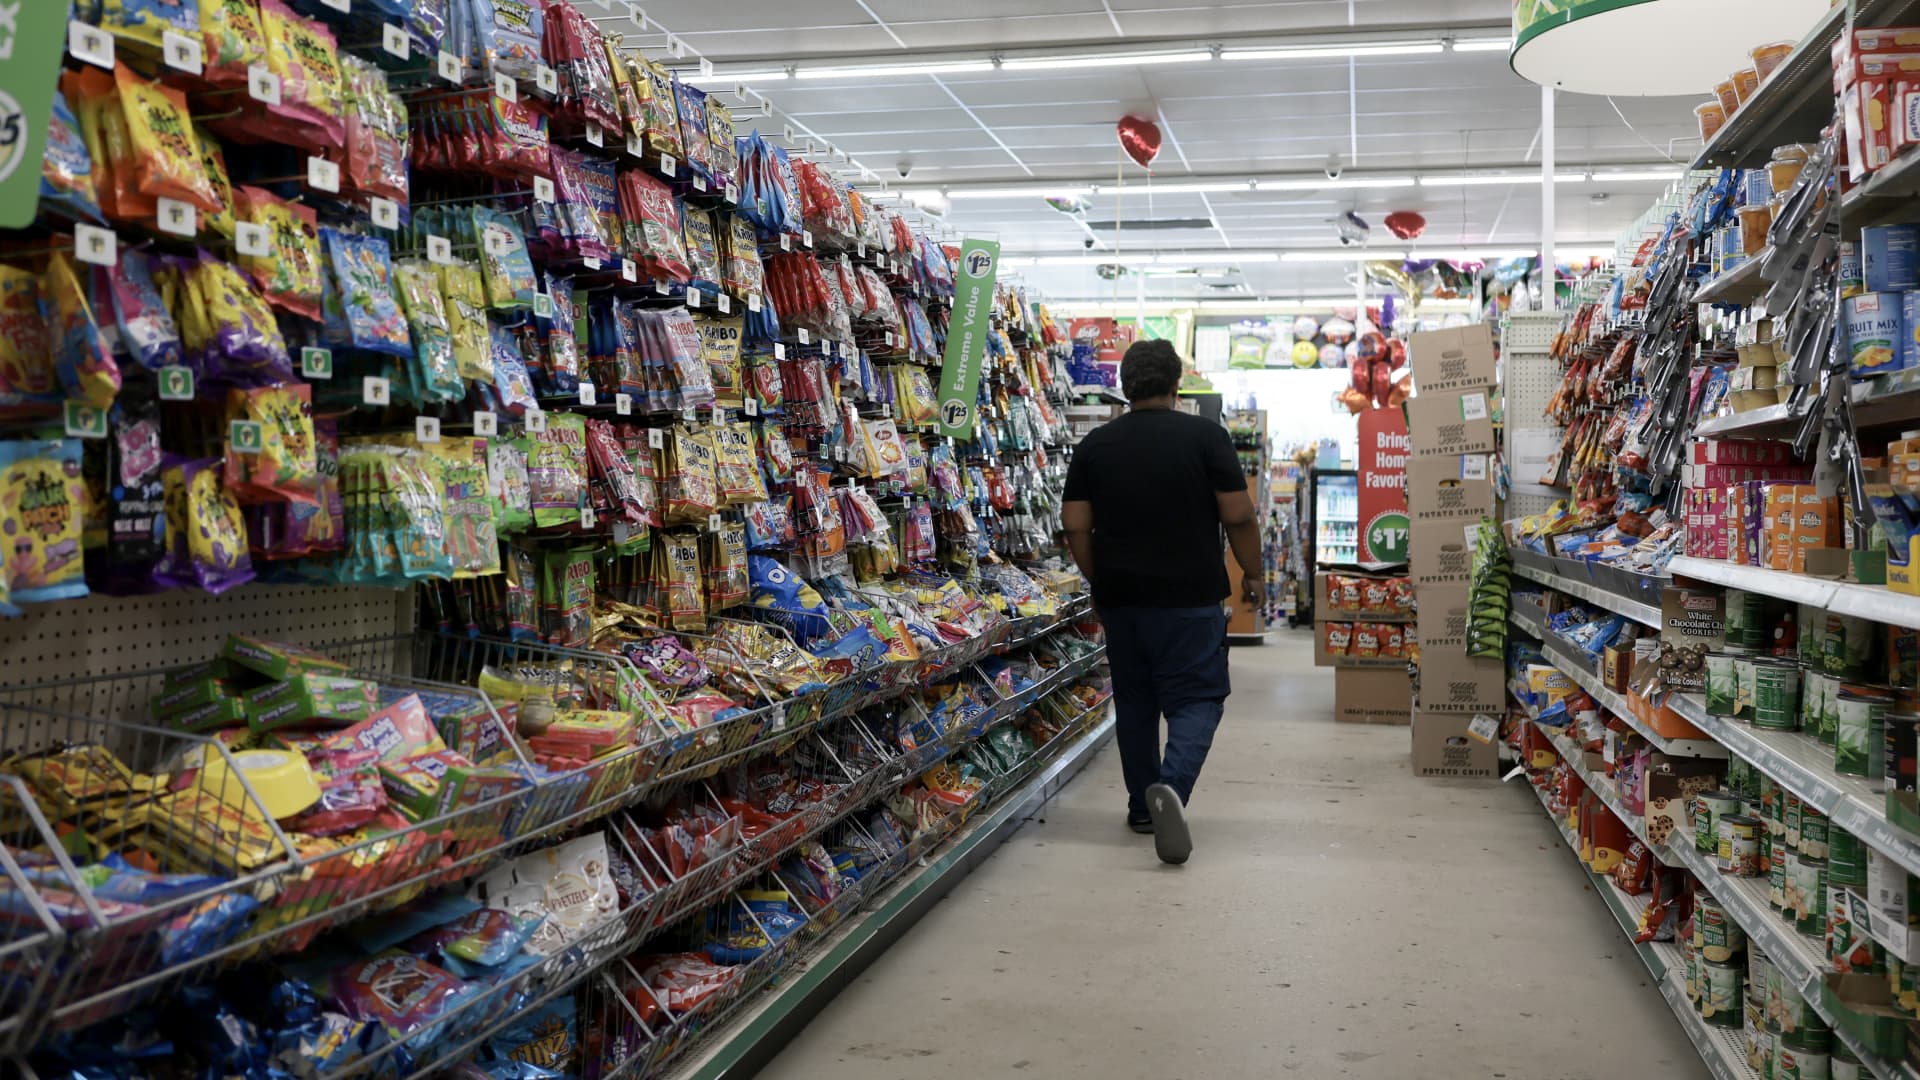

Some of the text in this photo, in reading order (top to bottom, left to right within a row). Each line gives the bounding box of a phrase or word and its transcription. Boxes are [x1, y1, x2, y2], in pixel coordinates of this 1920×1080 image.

[1876, 318, 1899, 330] MIX
[953, 285, 981, 392] Extreme Value
[1422, 376, 1489, 391] POTATO CHIPS
[1377, 431, 1411, 449] Bring
[1419, 442, 1487, 456] POTATO CHIPS
[1419, 507, 1486, 519] POTATO CHIPS
[1419, 575, 1456, 583] POTATO
[1687, 611, 1713, 621] White
[1669, 618, 1711, 629] Chocolate
[1681, 628, 1719, 637] COOKIES
[1426, 638, 1462, 646] POTATO
[1666, 676, 1682, 687] Little
[1429, 704, 1498, 712] POTATO CHIPS
[1422, 767, 1491, 777] POTATO CHIPS
[550, 888, 590, 911] PRETZELS
